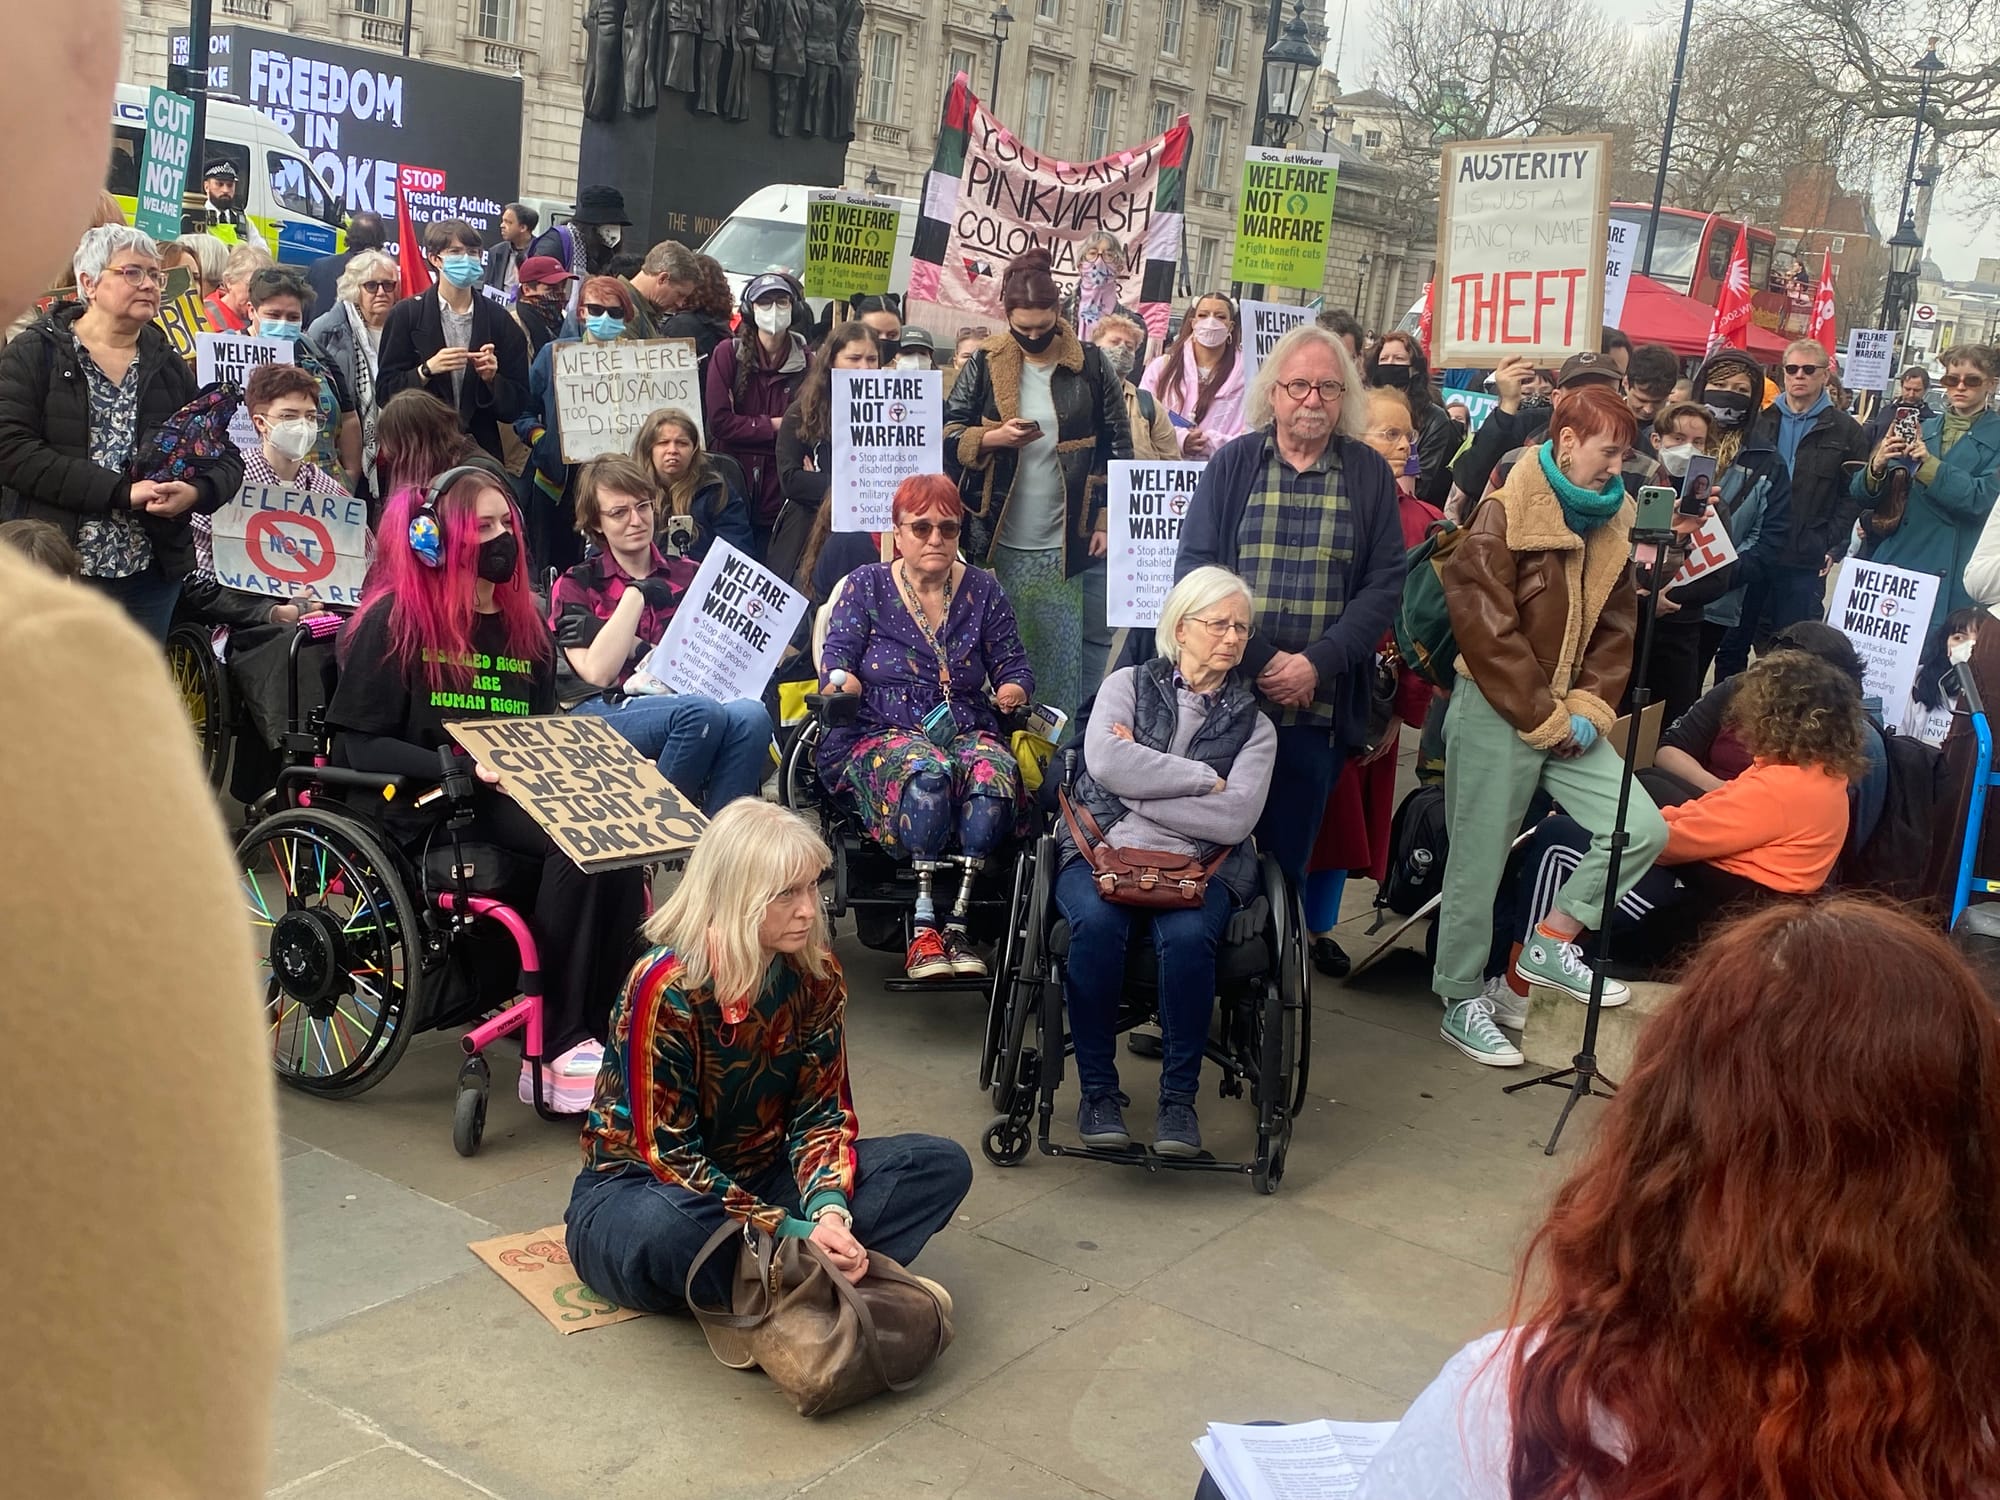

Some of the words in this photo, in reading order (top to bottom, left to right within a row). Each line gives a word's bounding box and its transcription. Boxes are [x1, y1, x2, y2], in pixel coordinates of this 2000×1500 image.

[250, 49, 403, 128] FREEDOM
[153, 95, 191, 135] CUT
[304, 113, 339, 150] IN
[981, 113, 1039, 172] YOU
[150, 128, 189, 168] WAR
[1295, 154, 1324, 166] Worker
[1458, 150, 1589, 183] AUSTERITY
[145, 160, 184, 200] NOT
[402, 169, 443, 189] STOP
[1249, 165, 1330, 194] WELFARE
[402, 189, 457, 210] Treating
[459, 196, 502, 215] Adults
[967, 156, 1153, 233] PINKWASH
[1245, 189, 1283, 214] NOT
[1464, 191, 1484, 214] IS
[1493, 189, 1541, 210] JUST
[1552, 188, 1567, 209] A
[143, 195, 178, 218] WELFARE
[409, 206, 429, 223] ike
[668, 212, 687, 232] THE
[694, 215, 723, 235] WOM
[837, 206, 895, 231] WELFARE
[1243, 214, 1325, 243] WARFARE
[834, 225, 863, 246] NOT
[1453, 222, 1518, 250] FANCY
[1534, 217, 1590, 245] NAME
[832, 245, 891, 269] WARFARE
[1246, 242, 1267, 256] Fight
[1269, 245, 1300, 258] benefit
[1302, 248, 1321, 260] cuts
[1507, 250, 1530, 265] FOR
[1244, 256, 1258, 268] Tax
[1261, 258, 1275, 270] the
[1277, 260, 1294, 272] rich
[1451, 268, 1588, 347] THEFT
[1856, 341, 1870, 349] NOT
[1858, 332, 1888, 342] WELFARE
[213, 341, 277, 365] WELFARE
[563, 350, 623, 376] WE'RE
[634, 349, 690, 370] HERE
[1855, 349, 1886, 360] WARFARE
[214, 363, 245, 384] NOT
[600, 372, 621, 381] FOR
[567, 379, 689, 405] THOUSANDS
[849, 378, 924, 400] WELFARE
[562, 406, 588, 421] TOO
[850, 402, 884, 423] NOT
[850, 425, 926, 447] WARFARE
[858, 452, 877, 464] Stop
[878, 452, 906, 462] attacks
[908, 454, 918, 462] on
[858, 464, 893, 474] disabled
[894, 465, 920, 477] people
[1129, 469, 1203, 492] WELFAR
[859, 478, 871, 487] No
[227, 486, 362, 526] ELFARE
[859, 489, 889, 500] military
[1129, 493, 1166, 516] NOT
[860, 504, 884, 513] Social
[860, 516, 879, 525] and
[1129, 518, 1185, 540] WARF
[269, 534, 317, 558] NOT
[1136, 545, 1157, 557] Stop
[1136, 557, 1172, 568] disabled
[721, 553, 791, 613] WELFARE
[1136, 572, 1149, 581] No
[1136, 582, 1168, 594] military
[1854, 567, 1920, 601] WELFARE
[710, 573, 748, 607] NOT
[1847, 589, 1880, 614] NOT
[1136, 598, 1161, 608] Social
[701, 592, 772, 653] WARFARE
[1135, 610, 1151, 620] and
[1843, 610, 1912, 644] WARFARE
[695, 631, 726, 654] disabled
[725, 651, 748, 672] people
[700, 619, 718, 637] Stop
[718, 631, 743, 653] attacks
[742, 650, 752, 661] on
[1863, 640, 1887, 655] attacks
[1887, 647, 1898, 657] on
[688, 641, 700, 654] No
[701, 647, 730, 674] increase
[729, 669, 737, 680] in
[1871, 655, 1897, 669] people
[472, 674, 502, 692] ARE
[672, 674, 688, 687] and
[677, 662, 701, 682] Social
[701, 679, 727, 701] security
[683, 651, 712, 675] military
[712, 670, 741, 698] spending
[430, 691, 486, 710] HUMAN
[462, 720, 557, 748] THEY
[548, 718, 620, 745] SAY
[489, 748, 565, 773] CUT
[557, 744, 648, 769] BACK
[512, 769, 569, 797] WE
[571, 766, 646, 792] SAY
[530, 791, 646, 824] FIGHT
[559, 822, 668, 857] BACK
